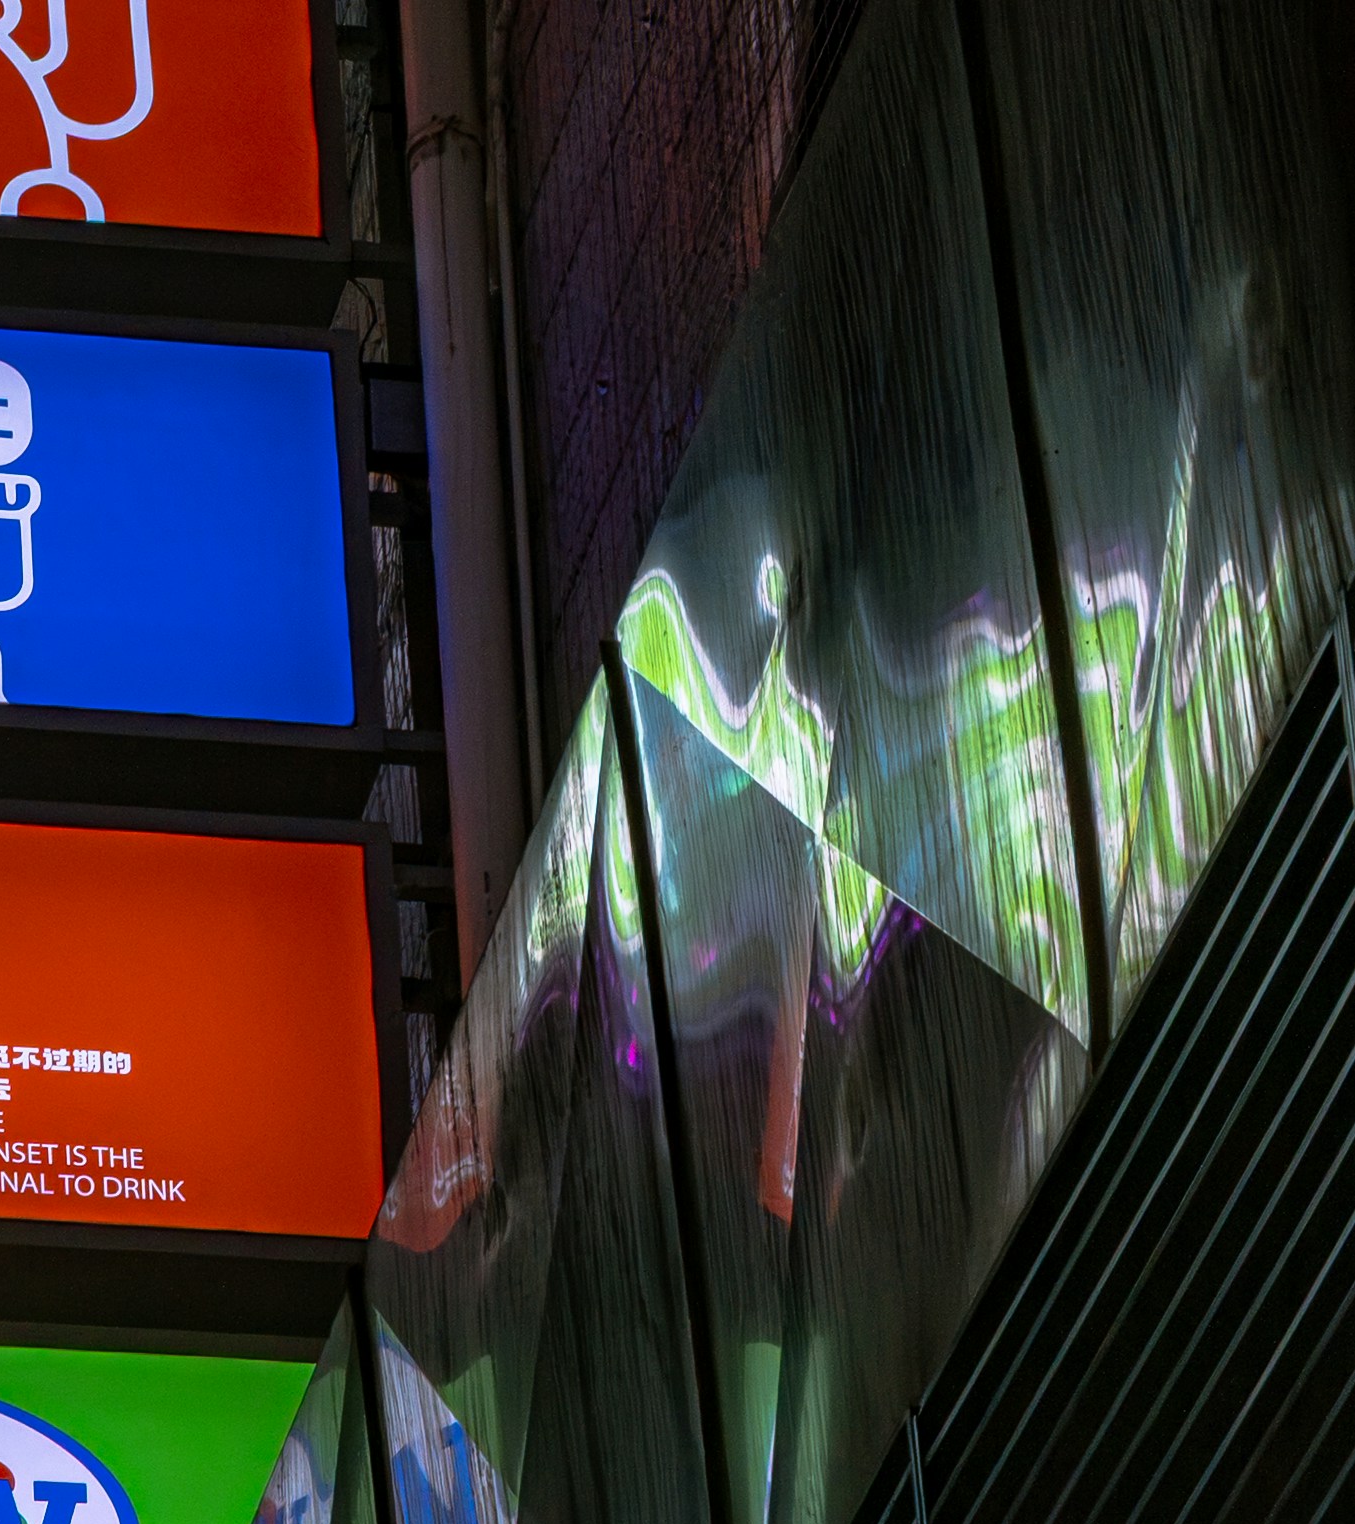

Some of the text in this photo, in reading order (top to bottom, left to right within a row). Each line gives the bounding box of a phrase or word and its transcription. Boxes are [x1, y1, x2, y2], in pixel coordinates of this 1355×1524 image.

[65, 1144, 88, 1167] IS
[91, 1146, 145, 1170] THE
[58, 1173, 95, 1196] TO
[102, 1175, 187, 1203] DRINK
